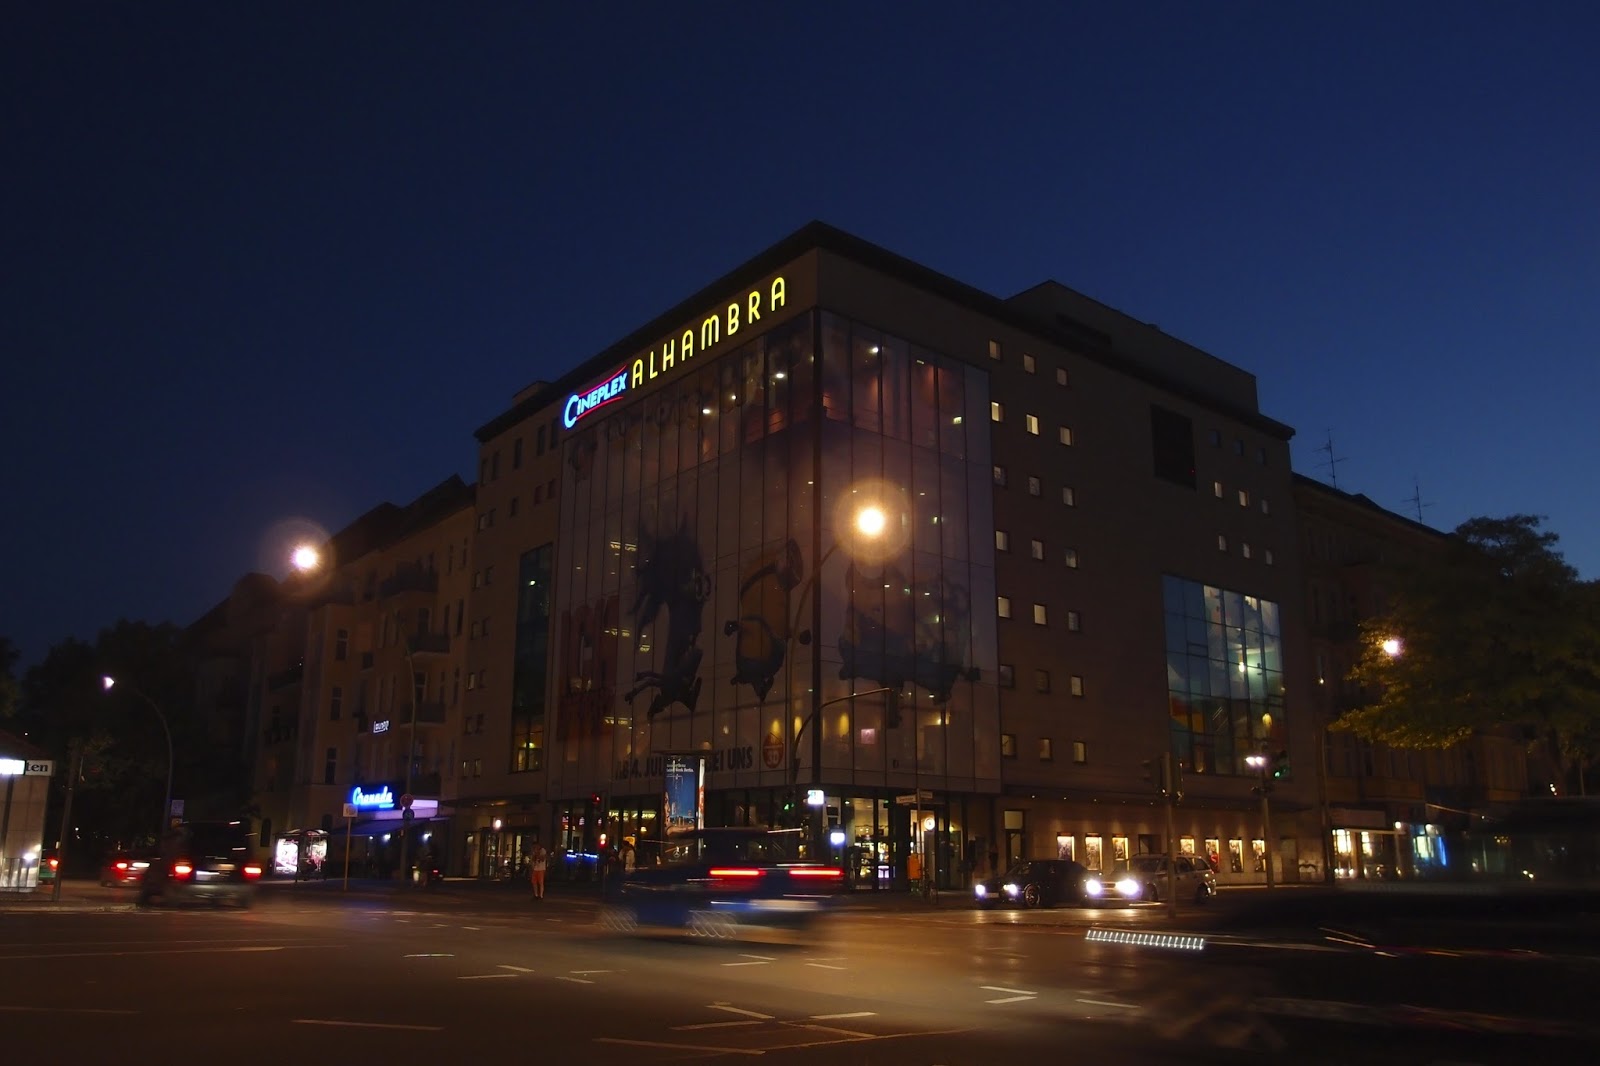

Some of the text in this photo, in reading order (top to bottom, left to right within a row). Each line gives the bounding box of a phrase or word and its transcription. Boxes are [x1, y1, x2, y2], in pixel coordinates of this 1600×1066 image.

[631, 275, 787, 390] ALHAMBRA
[644, 756, 663, 778] JUL
[727, 745, 753, 770] UNS
